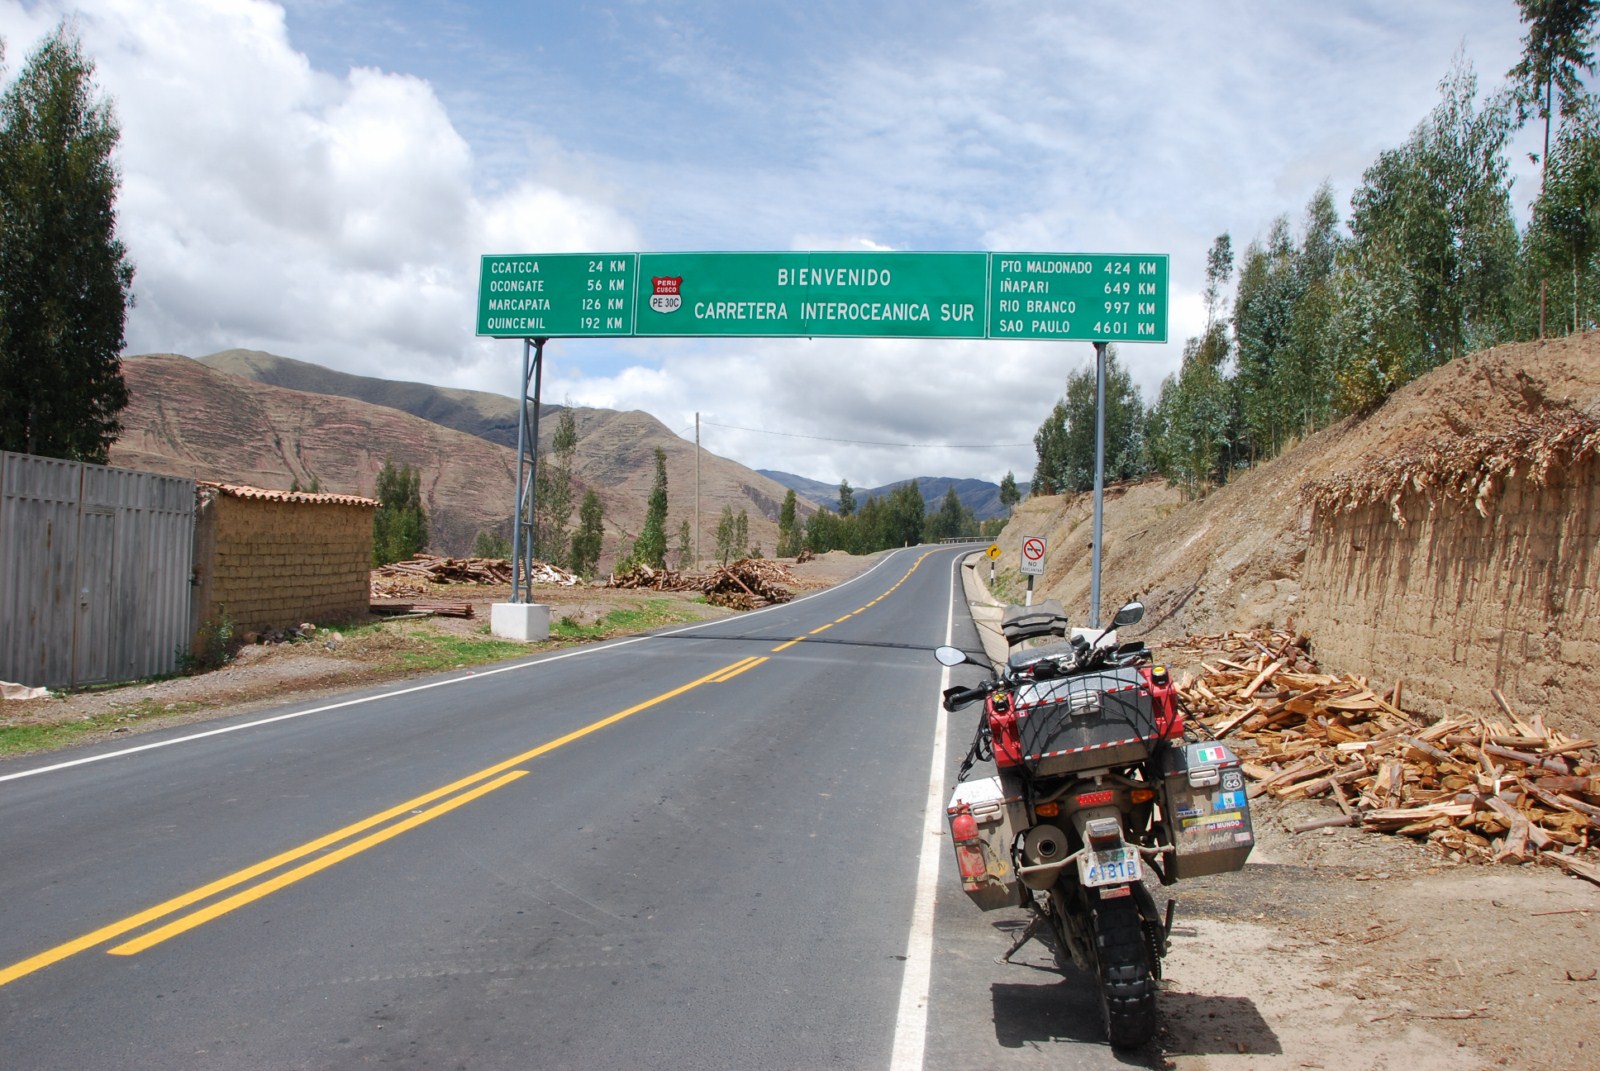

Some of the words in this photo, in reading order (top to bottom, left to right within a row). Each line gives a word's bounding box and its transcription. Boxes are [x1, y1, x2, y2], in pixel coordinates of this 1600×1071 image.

[491, 261, 539, 274] CCATCCA
[588, 261, 603, 273] 24
[610, 260, 626, 272] KM
[1026, 261, 1093, 274] MALDONADO
[1104, 262, 1131, 275] 424
[1139, 262, 1156, 275] KM
[778, 268, 891, 286] BIENVENIDO
[490, 280, 544, 292] OCONGATE
[587, 279, 602, 291] 56
[609, 279, 625, 291] KM
[1000, 278, 1049, 293] IÑAPARI
[1104, 282, 1130, 295] 649
[1138, 282, 1156, 295] KM
[488, 299, 551, 311] MARCAPATA
[582, 298, 601, 310] 126
[608, 298, 624, 310] KM
[653, 298, 663, 307] PE
[665, 298, 680, 307] 30C
[1000, 299, 1020, 312] RIO
[1027, 300, 1076, 314] BRANCO
[1104, 301, 1130, 314] 997
[1138, 302, 1155, 315] KM
[694, 302, 788, 320] CARRETERA
[801, 302, 931, 321] INTEROCEANICA
[940, 303, 975, 321] SUR
[487, 317, 546, 330] QUINCEMIL
[580, 317, 600, 329] 192
[607, 317, 623, 329] KM
[1000, 319, 1024, 332] SAO
[1032, 320, 1070, 333] PAULO
[1093, 321, 1127, 334] 4601
[1137, 322, 1155, 335] KM
[1226, 779, 1240, 788] 66
[1217, 820, 1240, 830] MUNDO
